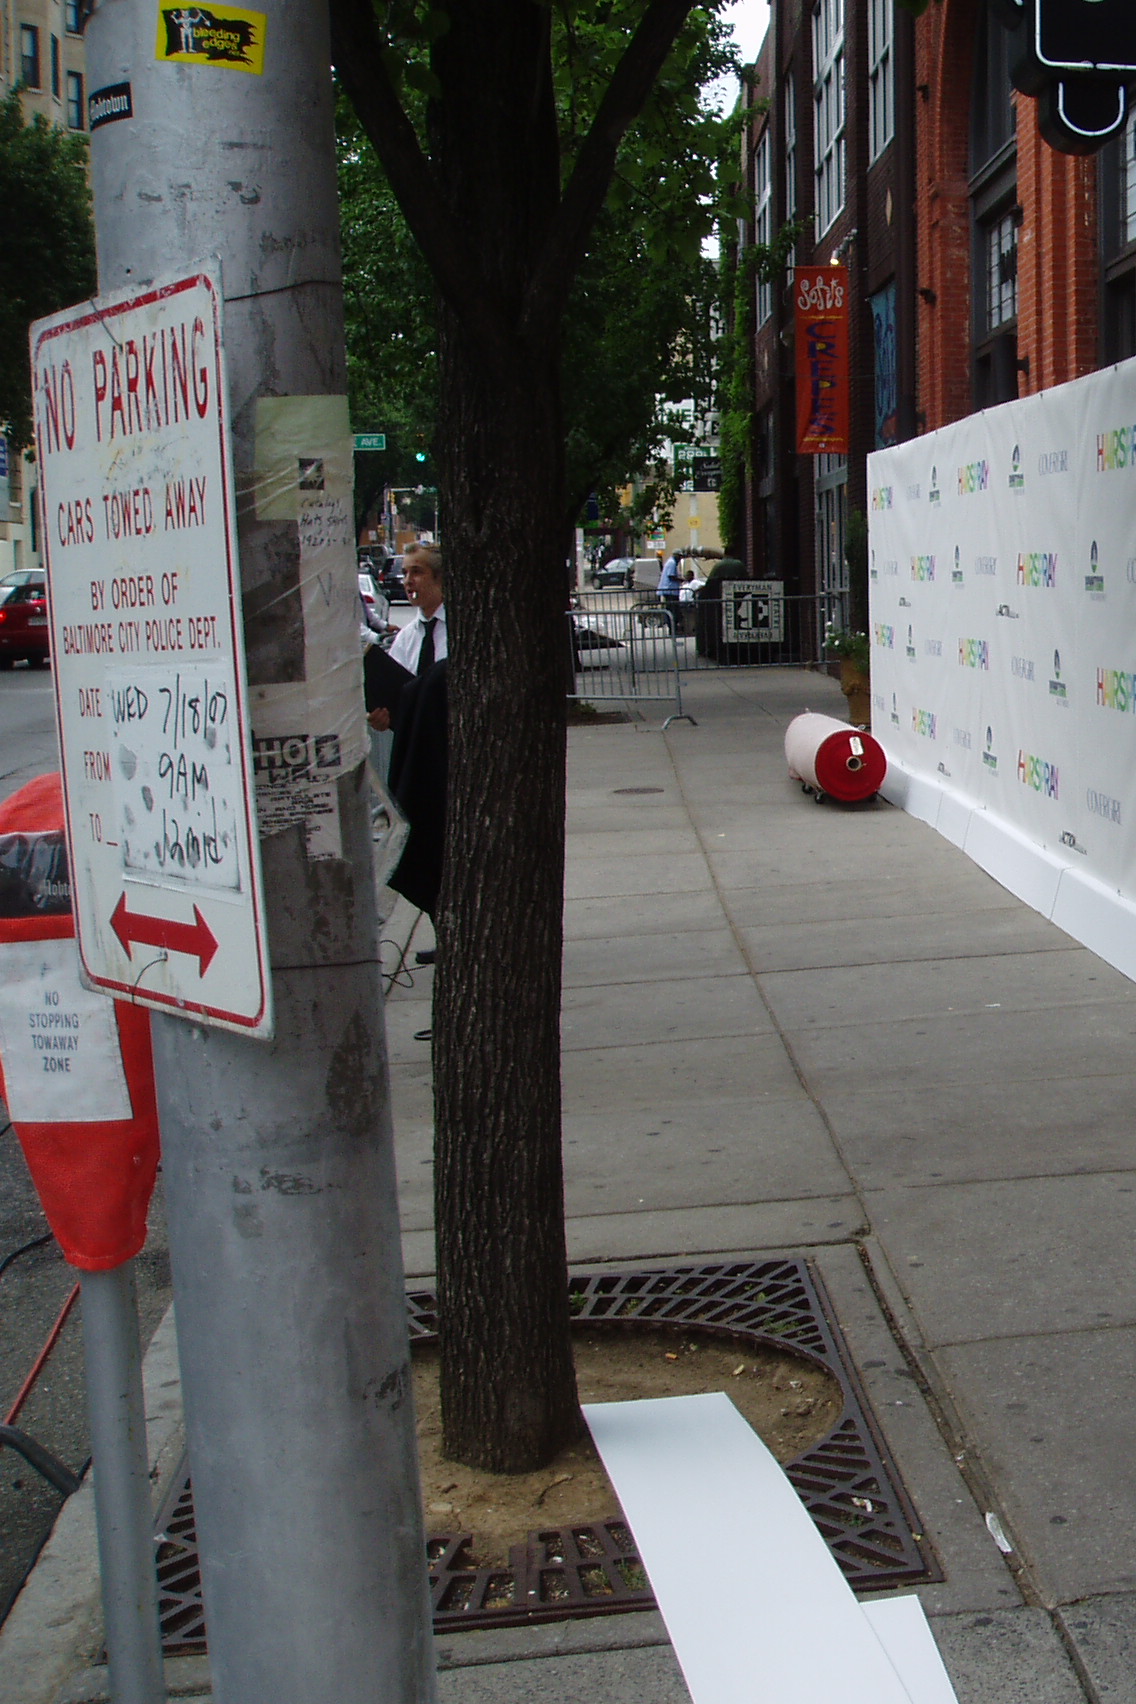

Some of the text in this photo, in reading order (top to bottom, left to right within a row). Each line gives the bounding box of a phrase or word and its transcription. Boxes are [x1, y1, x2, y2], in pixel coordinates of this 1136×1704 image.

[44, 315, 209, 455] NO PARKING
[58, 475, 207, 547] CARS TOWED AWAY
[90, 571, 178, 611] BY ORDER OF
[63, 615, 221, 654] BALTIMORE CITY POLICE DEPT.
[79, 688, 102, 718] DATE
[111, 672, 227, 750] WED 7/18/07
[84, 751, 112, 781] FROM
[159, 753, 209, 801] 9AM
[89, 813, 102, 843] TO
[45, 992, 60, 1007] NO
[29, 1013, 80, 1029] STOPPING
[31, 1034, 80, 1051] TOWAWAY
[43, 1056, 71, 1073] ZONE
